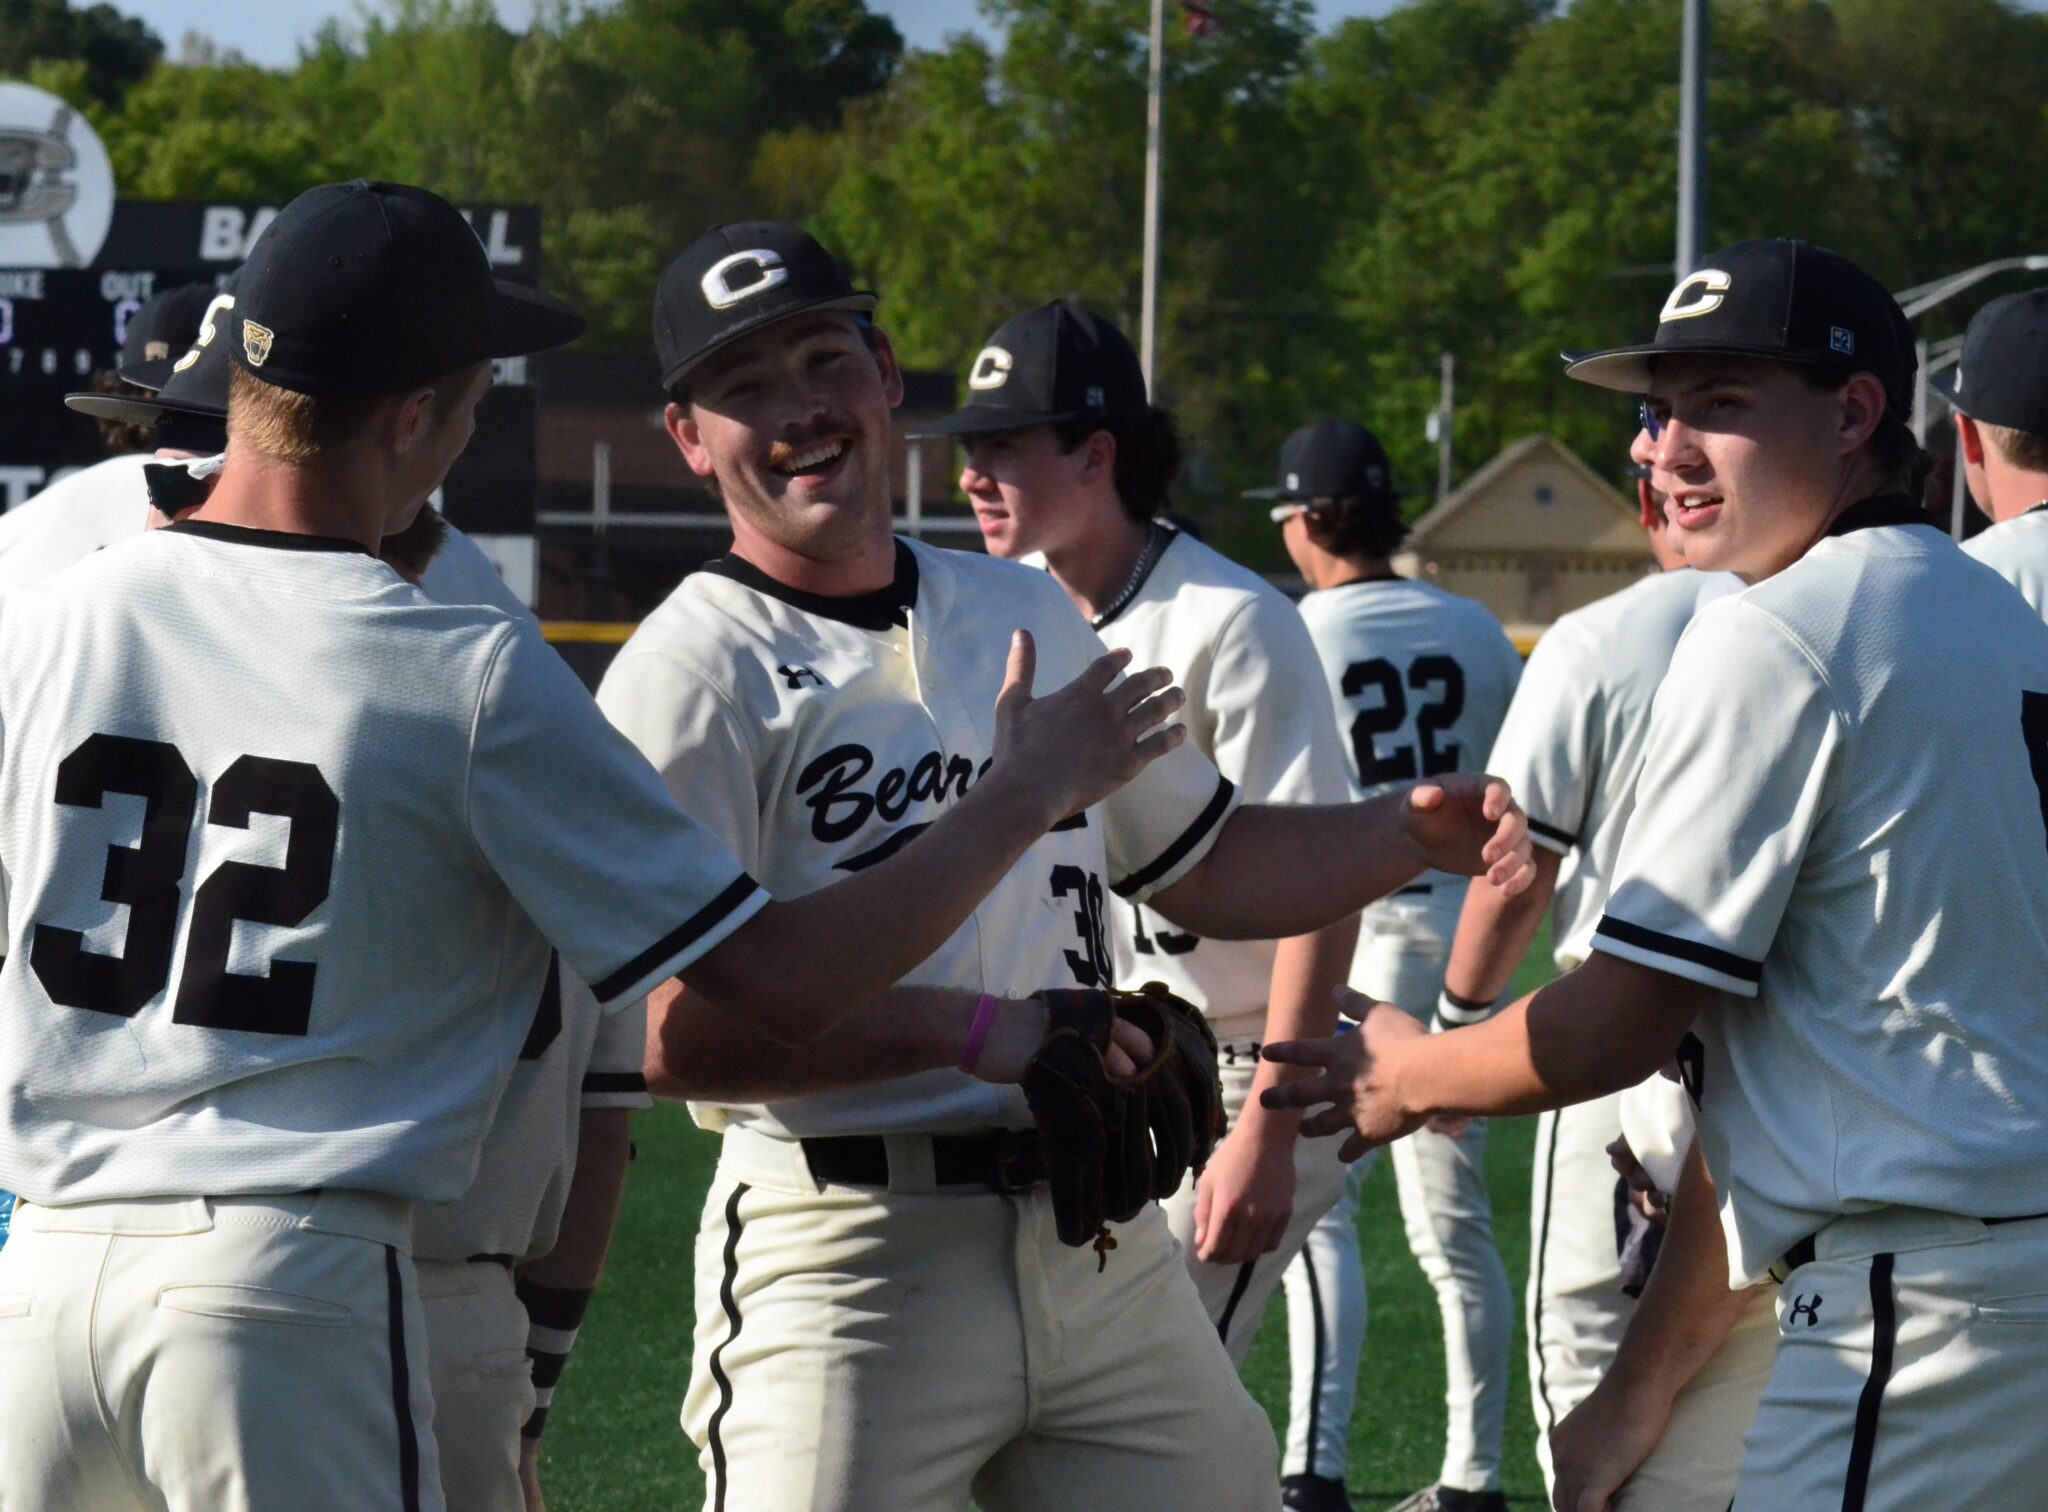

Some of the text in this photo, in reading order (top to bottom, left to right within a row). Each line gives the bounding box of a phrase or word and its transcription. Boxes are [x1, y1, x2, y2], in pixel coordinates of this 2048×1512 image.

[101, 271, 156, 301] OUT
[701, 248, 788, 309] C
[1659, 268, 1732, 323] C
[969, 346, 1014, 390] C
[1341, 655, 1466, 787] 22
[30, 732, 340, 1036] 32
